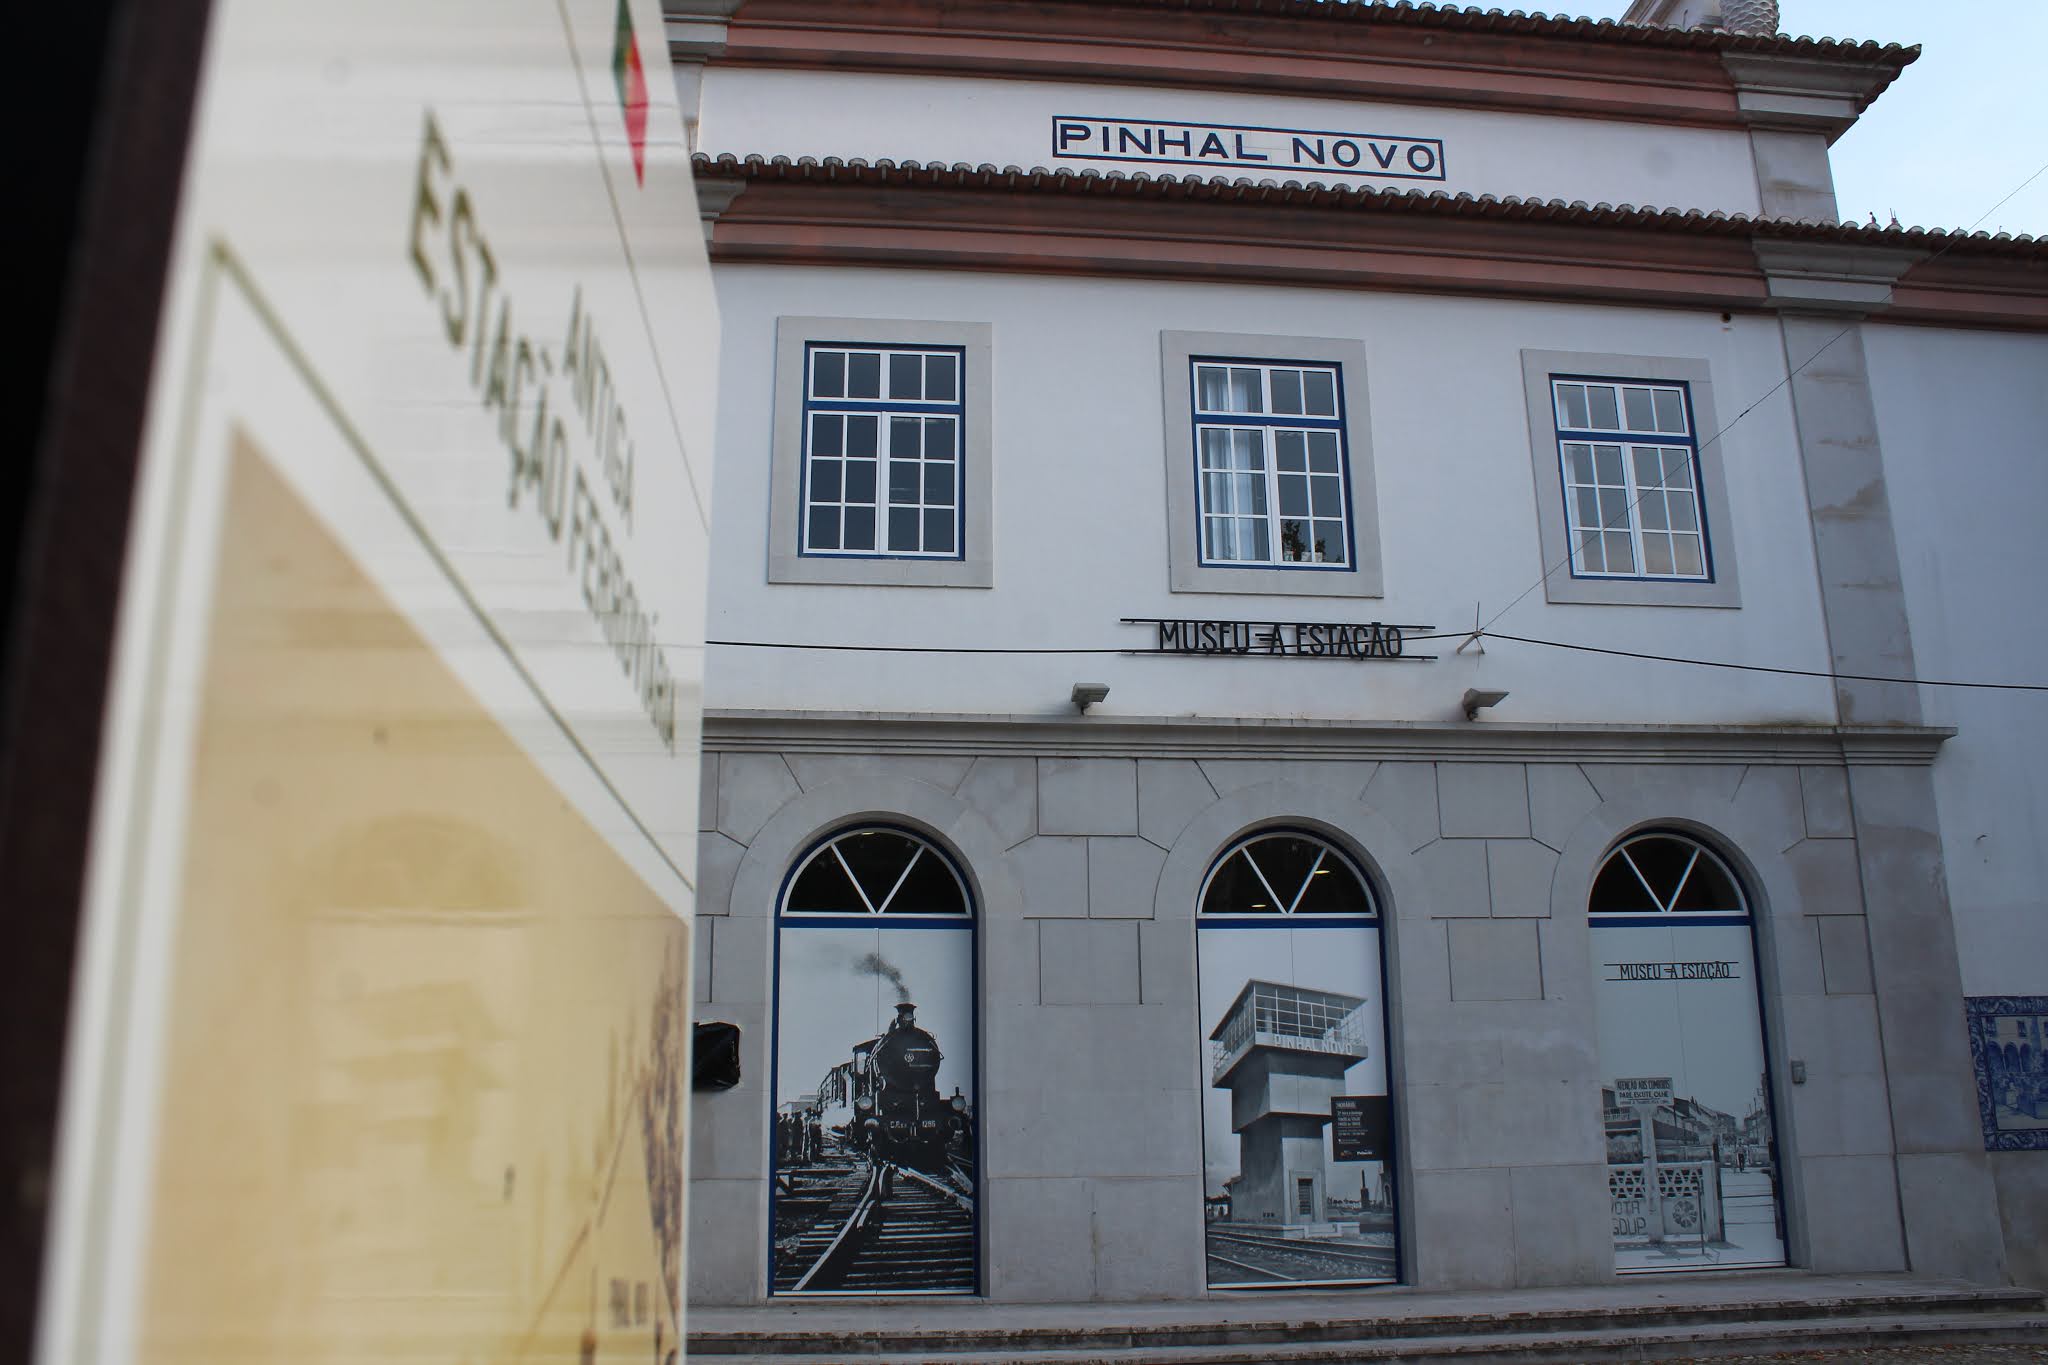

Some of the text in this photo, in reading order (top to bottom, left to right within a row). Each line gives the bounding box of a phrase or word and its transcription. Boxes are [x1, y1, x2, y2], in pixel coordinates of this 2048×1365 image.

[1059, 123, 1435, 173] PINHAL NOVO
[407, 106, 568, 544] ESTAÇÃO
[1159, 620, 1251, 652] MUSEU
[1295, 621, 1402, 660] ESTAÇÃO
[1619, 964, 1661, 980] MUSEU
[1682, 961, 1730, 980] ESTAÇÃO
[1274, 1034, 1353, 1056] PINHAL NOVO
